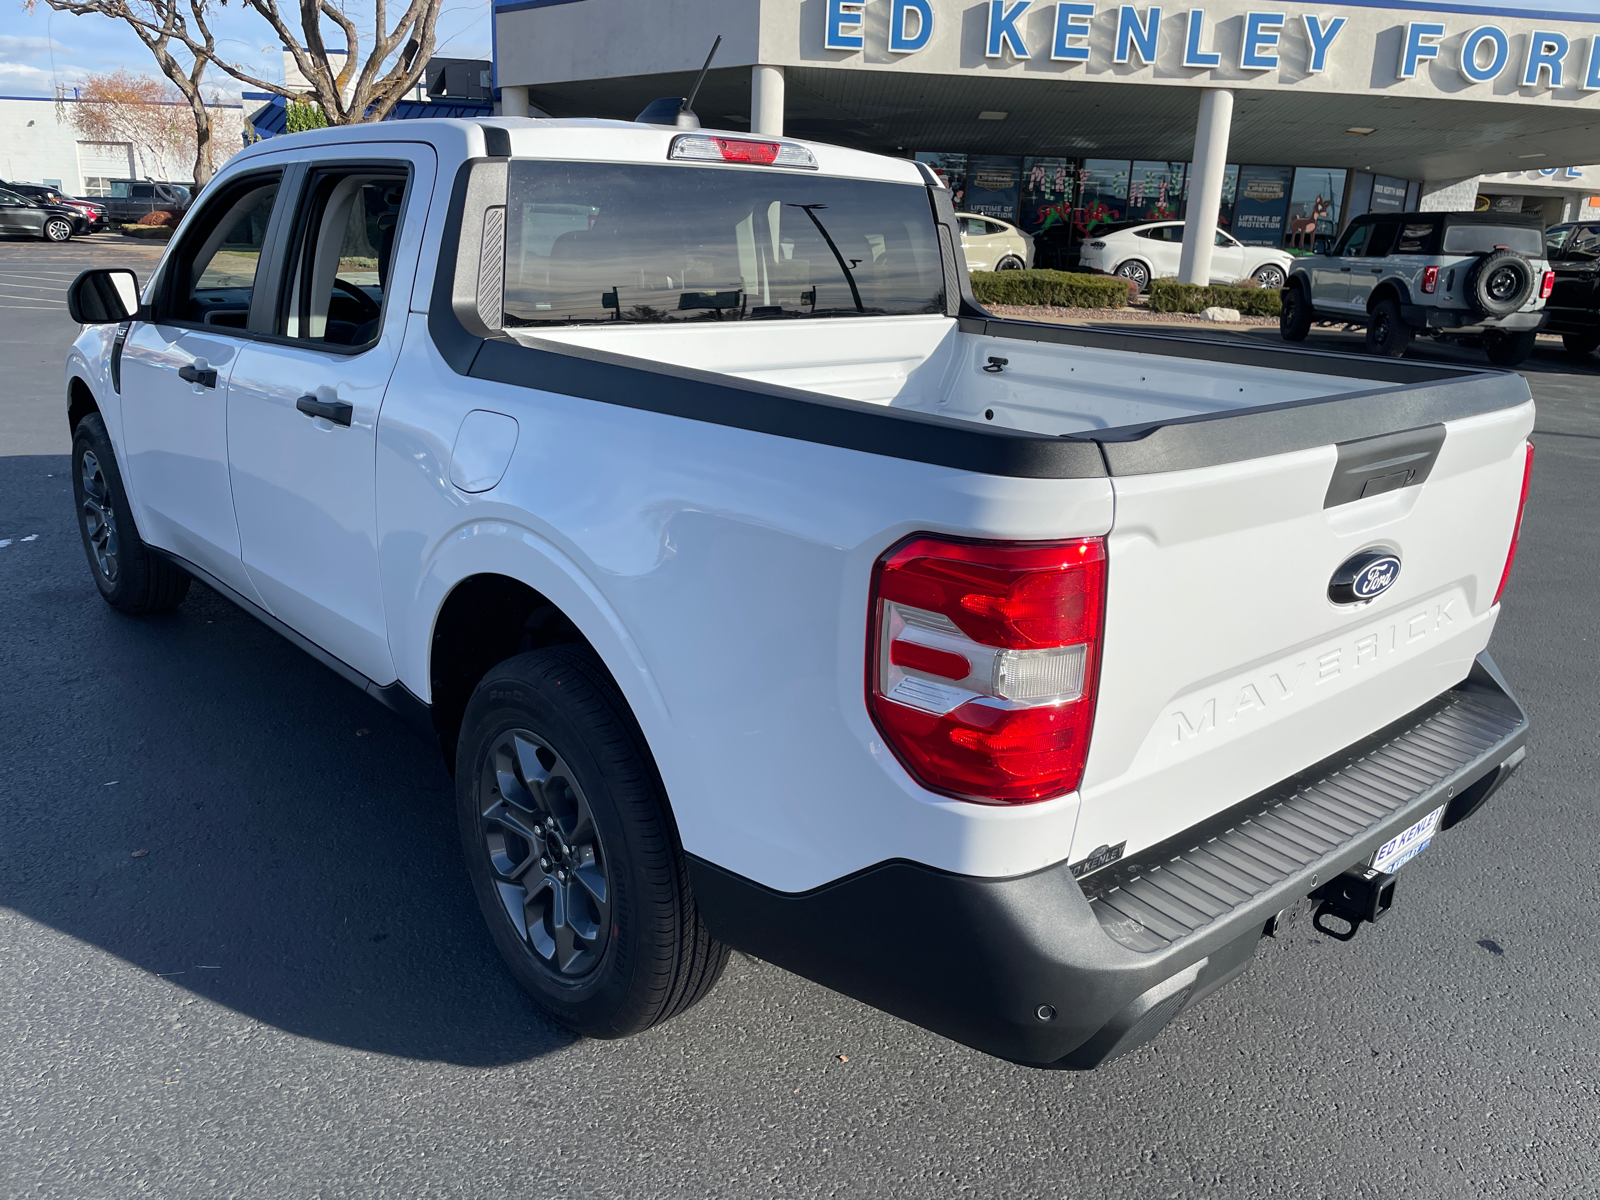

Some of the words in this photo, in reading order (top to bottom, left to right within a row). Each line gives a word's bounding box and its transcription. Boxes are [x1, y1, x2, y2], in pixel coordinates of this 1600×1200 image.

[825, 0, 935, 53] ED
[985, 0, 1348, 73] KENLEY
[970, 204, 1002, 212] LIFETIME
[1238, 214, 1270, 222] LIFETIME
[1237, 221, 1281, 229] PROTECTION
[1361, 562, 1395, 594] Ford
[1171, 598, 1456, 746] MAVERICK
[1377, 838, 1398, 861] ED
[1398, 809, 1440, 849] KENLEY
[1082, 845, 1126, 873] KENLEY
